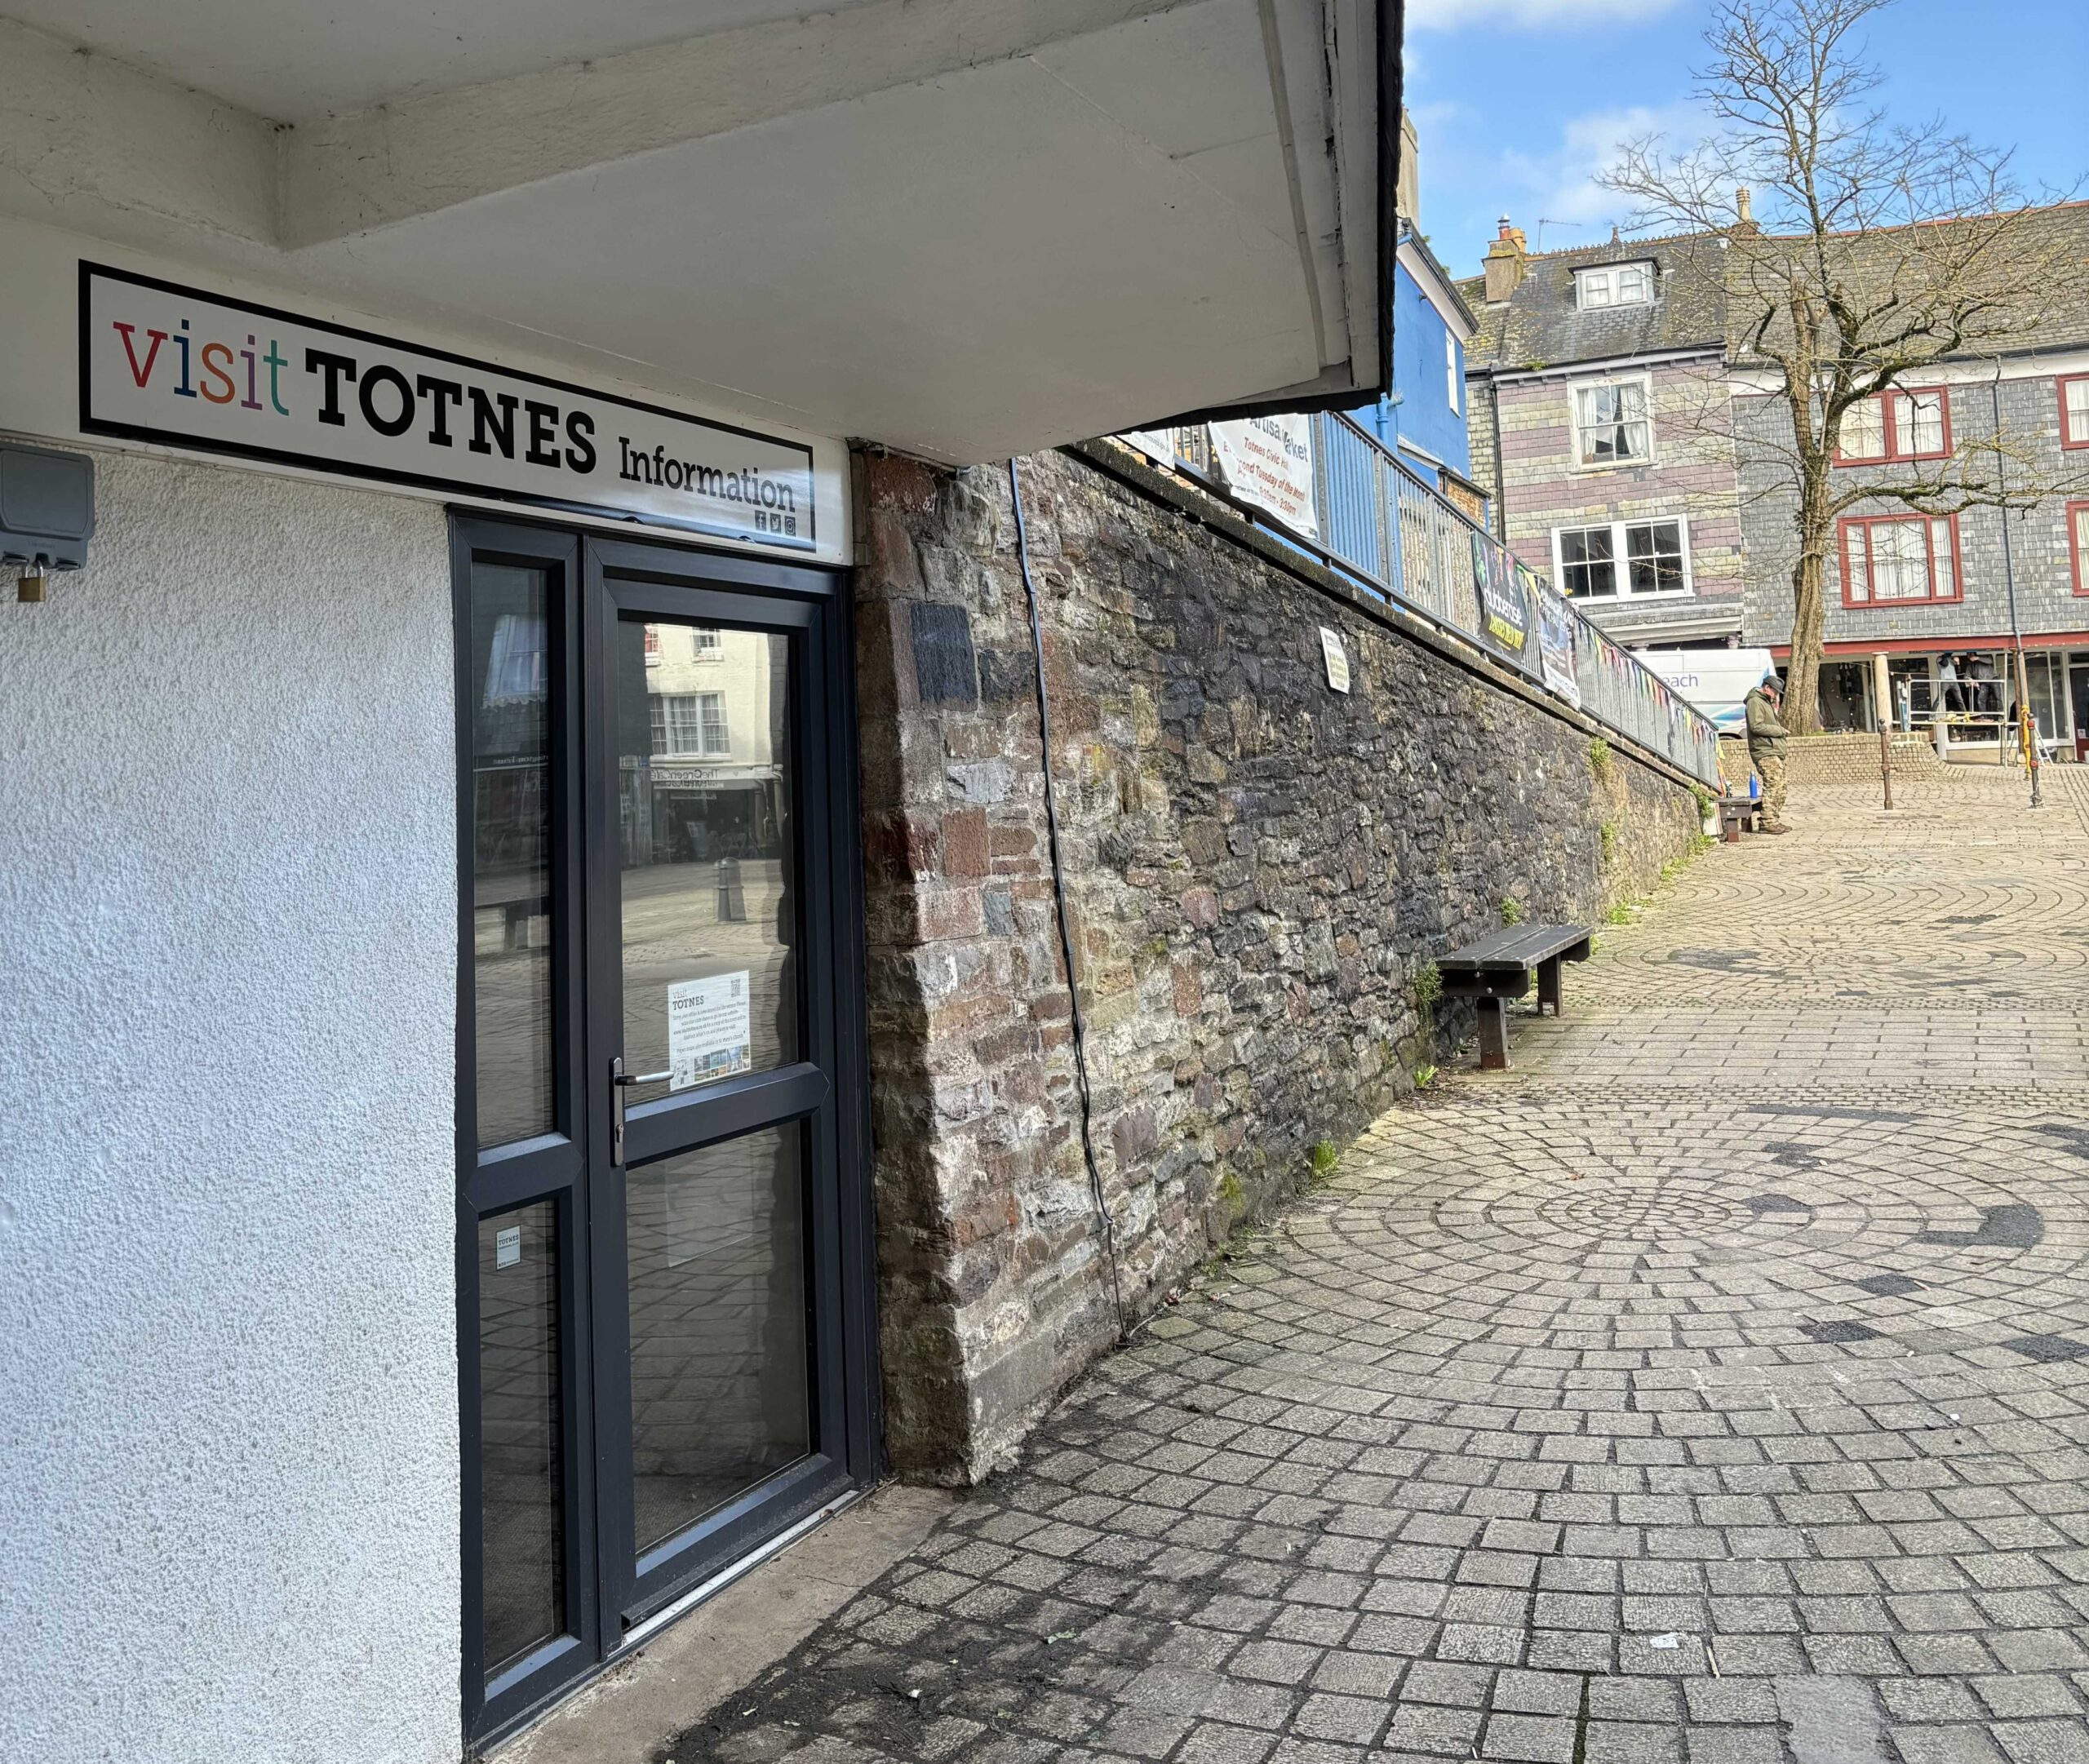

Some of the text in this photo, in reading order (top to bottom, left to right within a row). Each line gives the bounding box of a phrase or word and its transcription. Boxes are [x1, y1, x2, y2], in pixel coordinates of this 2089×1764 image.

[113, 319, 796, 512] visit TOTNES Information
[1244, 437, 1265, 457] Totnes
[1266, 448, 1280, 464] Civic
[1256, 465, 1278, 488] Tuesday
[672, 995, 704, 1010] TOTNES
[499, 1234, 519, 1246] TOTNES
